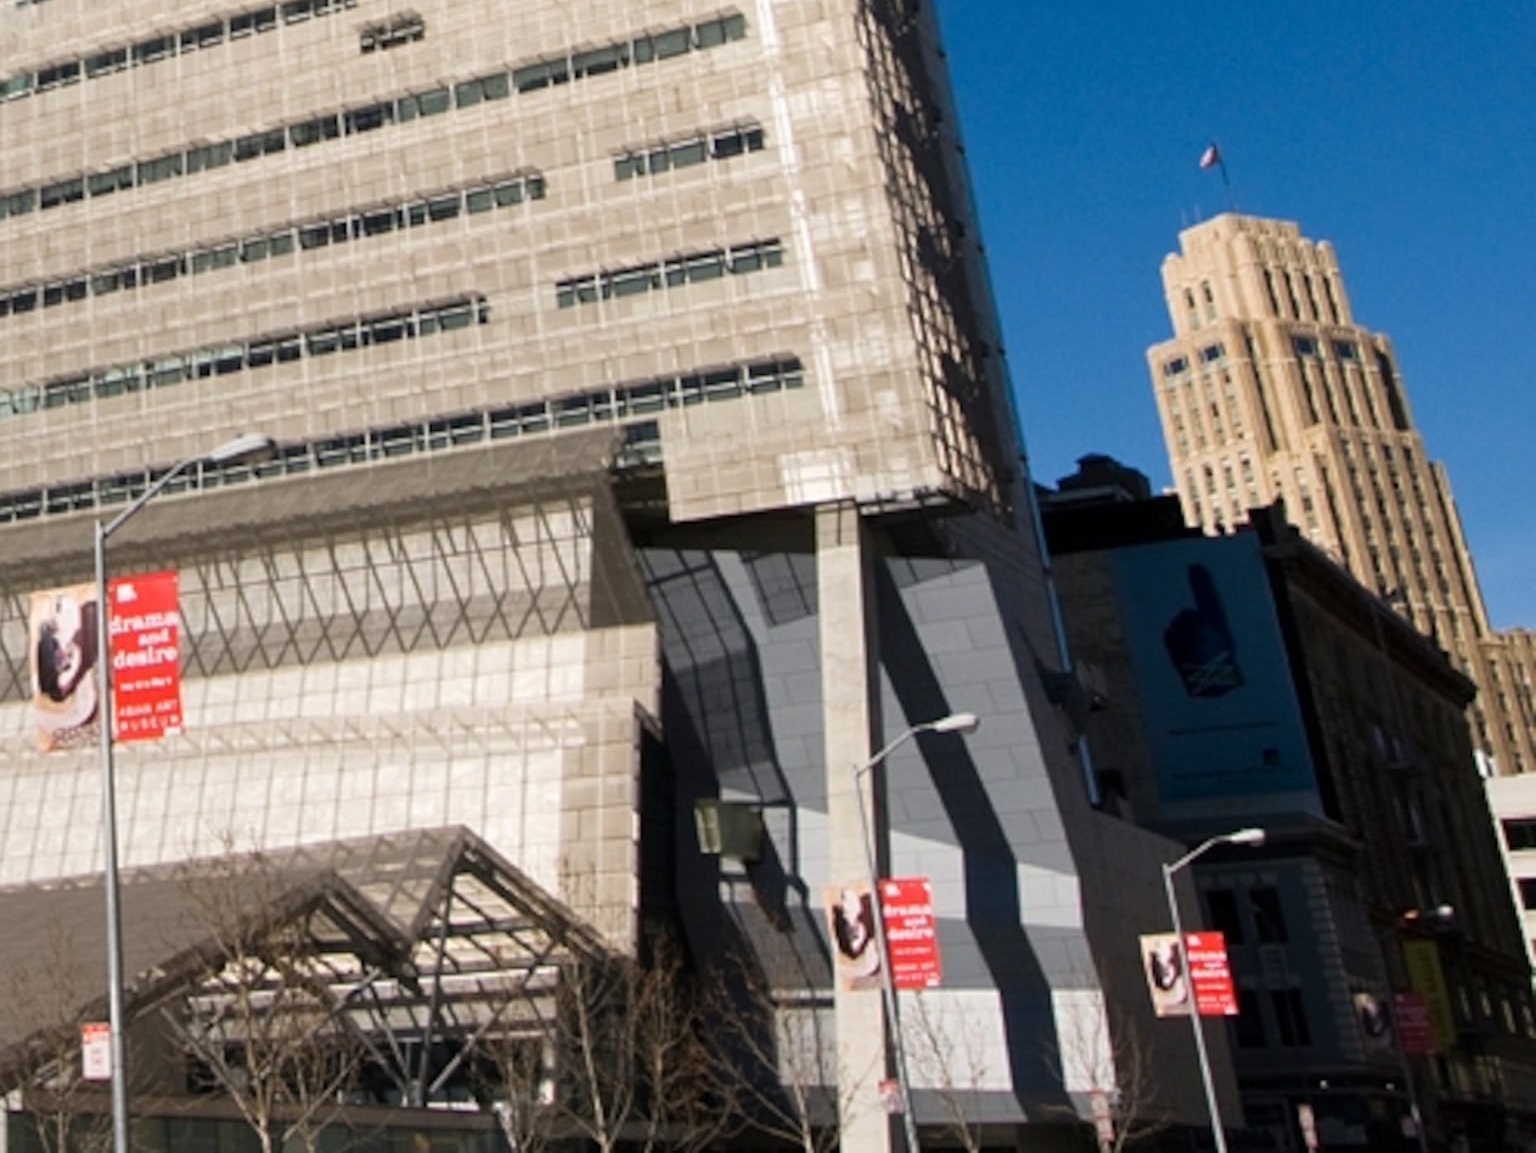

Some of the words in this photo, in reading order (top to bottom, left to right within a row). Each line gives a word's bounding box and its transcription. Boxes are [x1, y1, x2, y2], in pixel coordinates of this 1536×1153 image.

[109, 612, 178, 634] drama
[138, 628, 170, 646] and
[114, 646, 178, 669] desire
